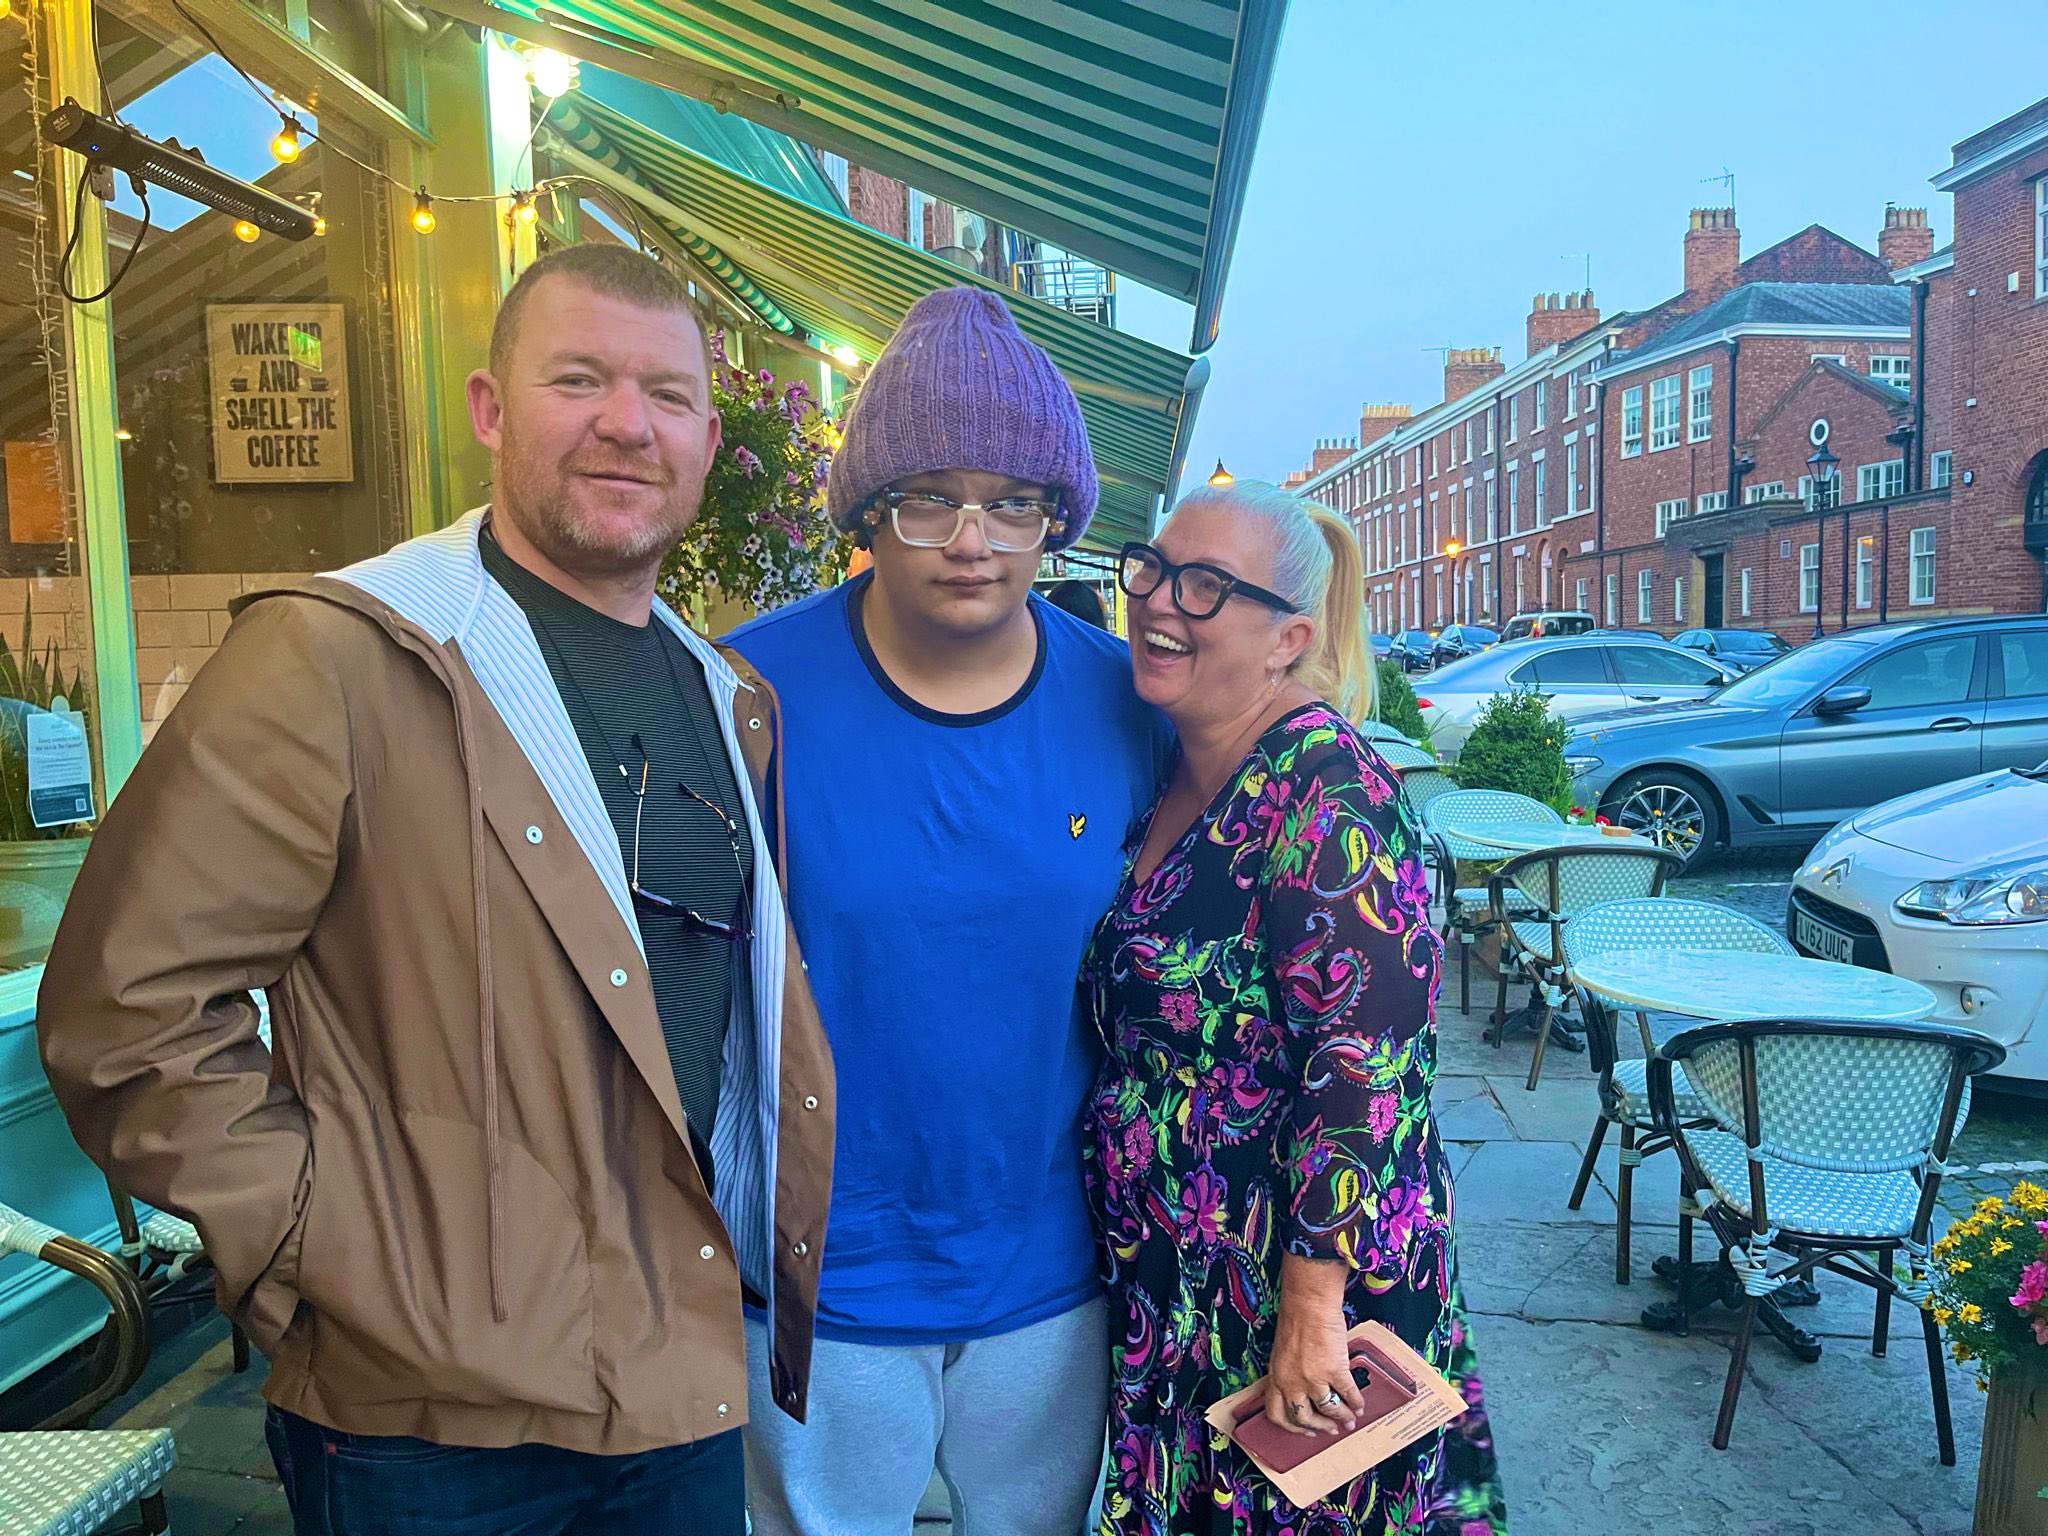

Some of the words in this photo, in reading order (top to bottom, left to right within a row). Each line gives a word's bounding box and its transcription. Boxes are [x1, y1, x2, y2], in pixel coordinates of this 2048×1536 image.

[231, 322, 290, 355] WAKE
[258, 360, 300, 392] AND
[226, 397, 293, 430] SMELL
[298, 397, 337, 430] THE
[247, 434, 320, 468] COFFEE
[1799, 917, 1823, 952] LY62
[1825, 931, 1848, 963] UUC
